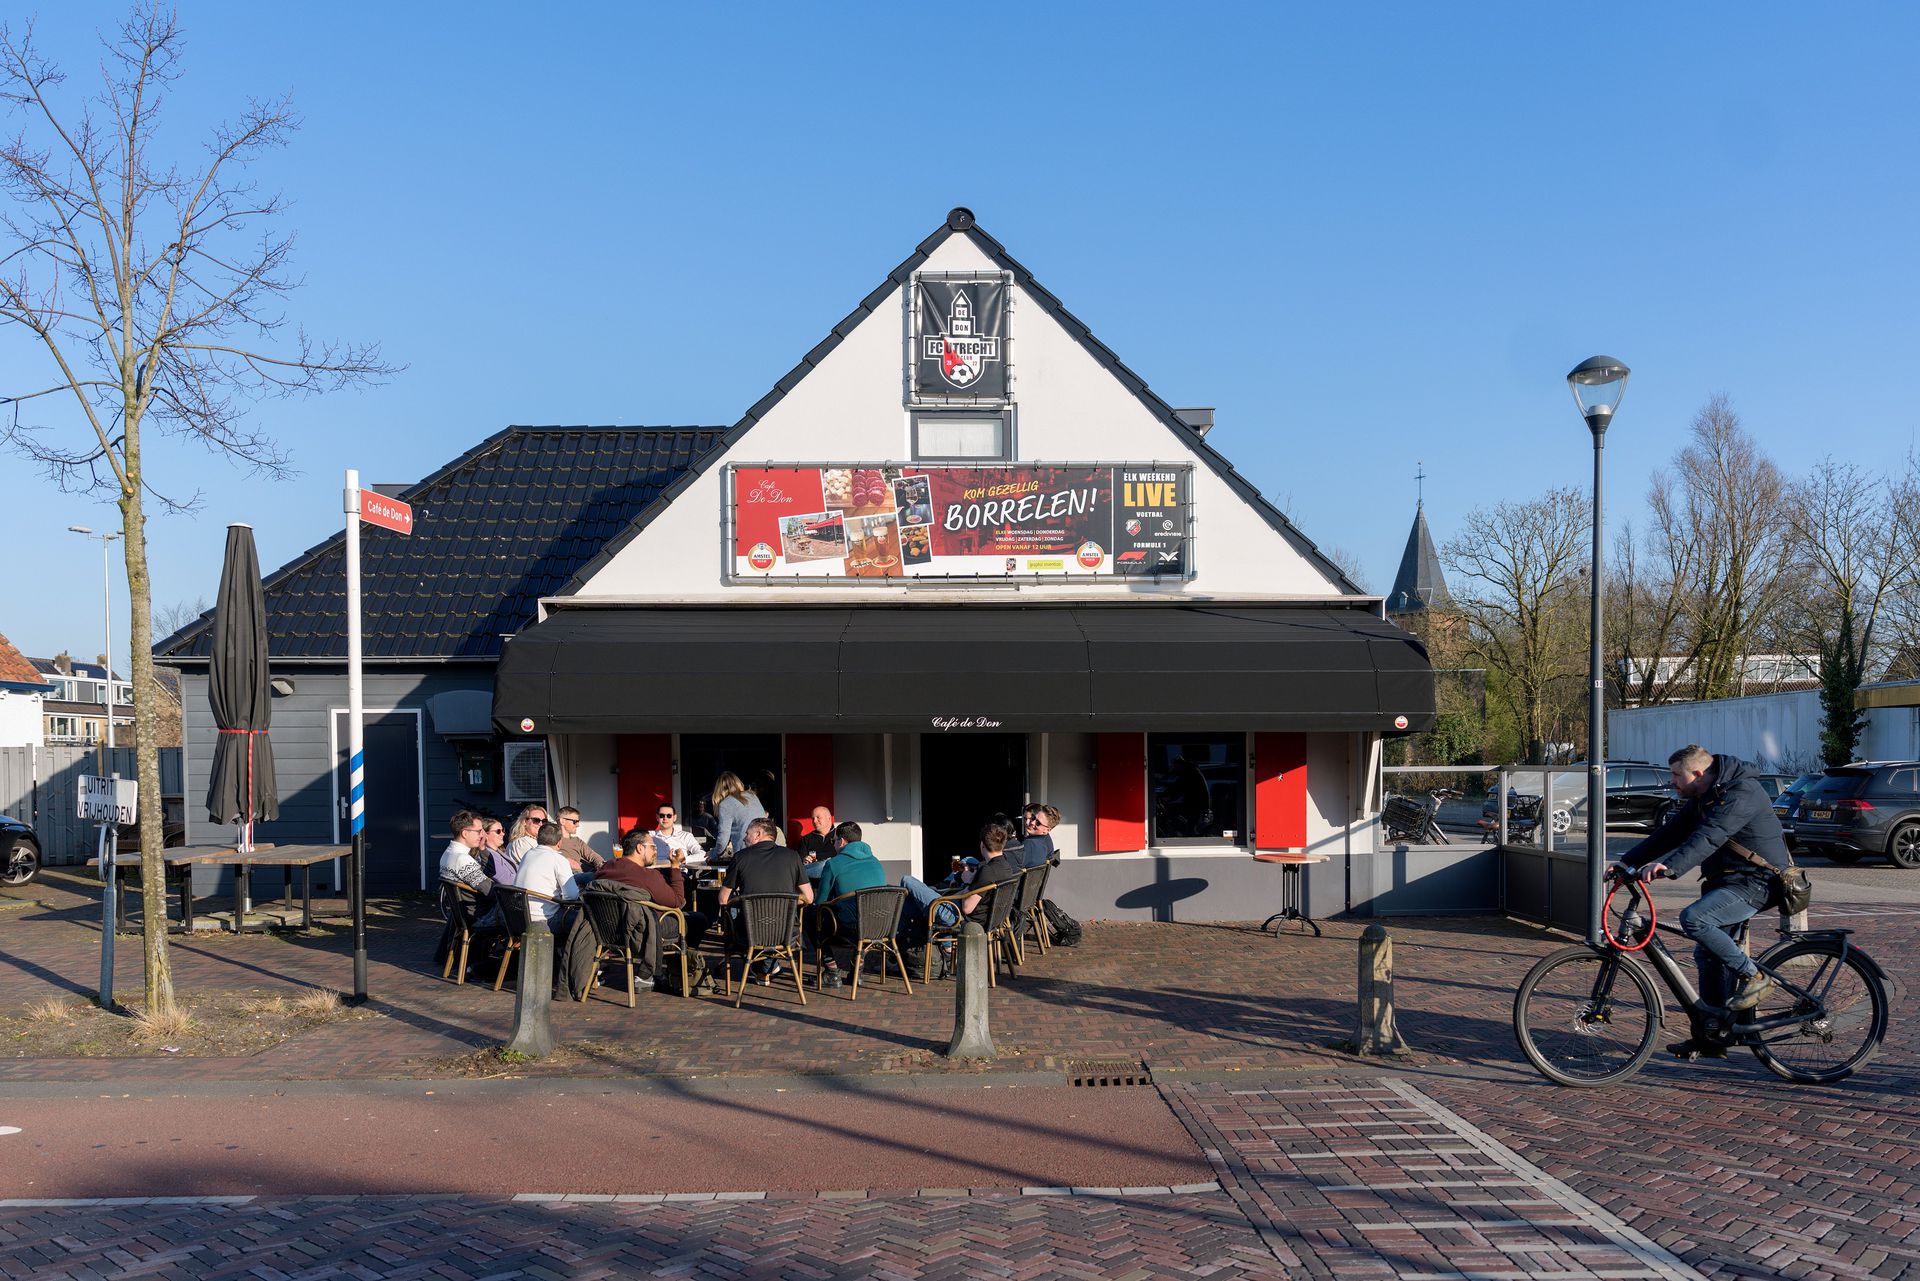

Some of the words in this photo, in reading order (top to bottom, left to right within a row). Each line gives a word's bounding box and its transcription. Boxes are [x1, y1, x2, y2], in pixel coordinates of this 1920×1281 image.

[930, 342, 943, 354] FC
[946, 343, 994, 355] UTRECHT
[1124, 473, 1138, 481] ELK
[1139, 473, 1176, 481] WEEKEND
[767, 488, 794, 503] Don
[963, 488, 986, 500] KOM
[987, 480, 1039, 497] GEZELLIG
[1124, 483, 1176, 507] LIVE
[382, 505, 390, 518] de
[390, 508, 403, 522] Don
[944, 487, 1098, 531] BORRELEN!
[931, 716, 960, 731] Café
[960, 717, 975, 728] de
[976, 716, 1003, 728] Don
[87, 777, 114, 796] UITRIT
[78, 801, 132, 823] VRIJHOUDEN
